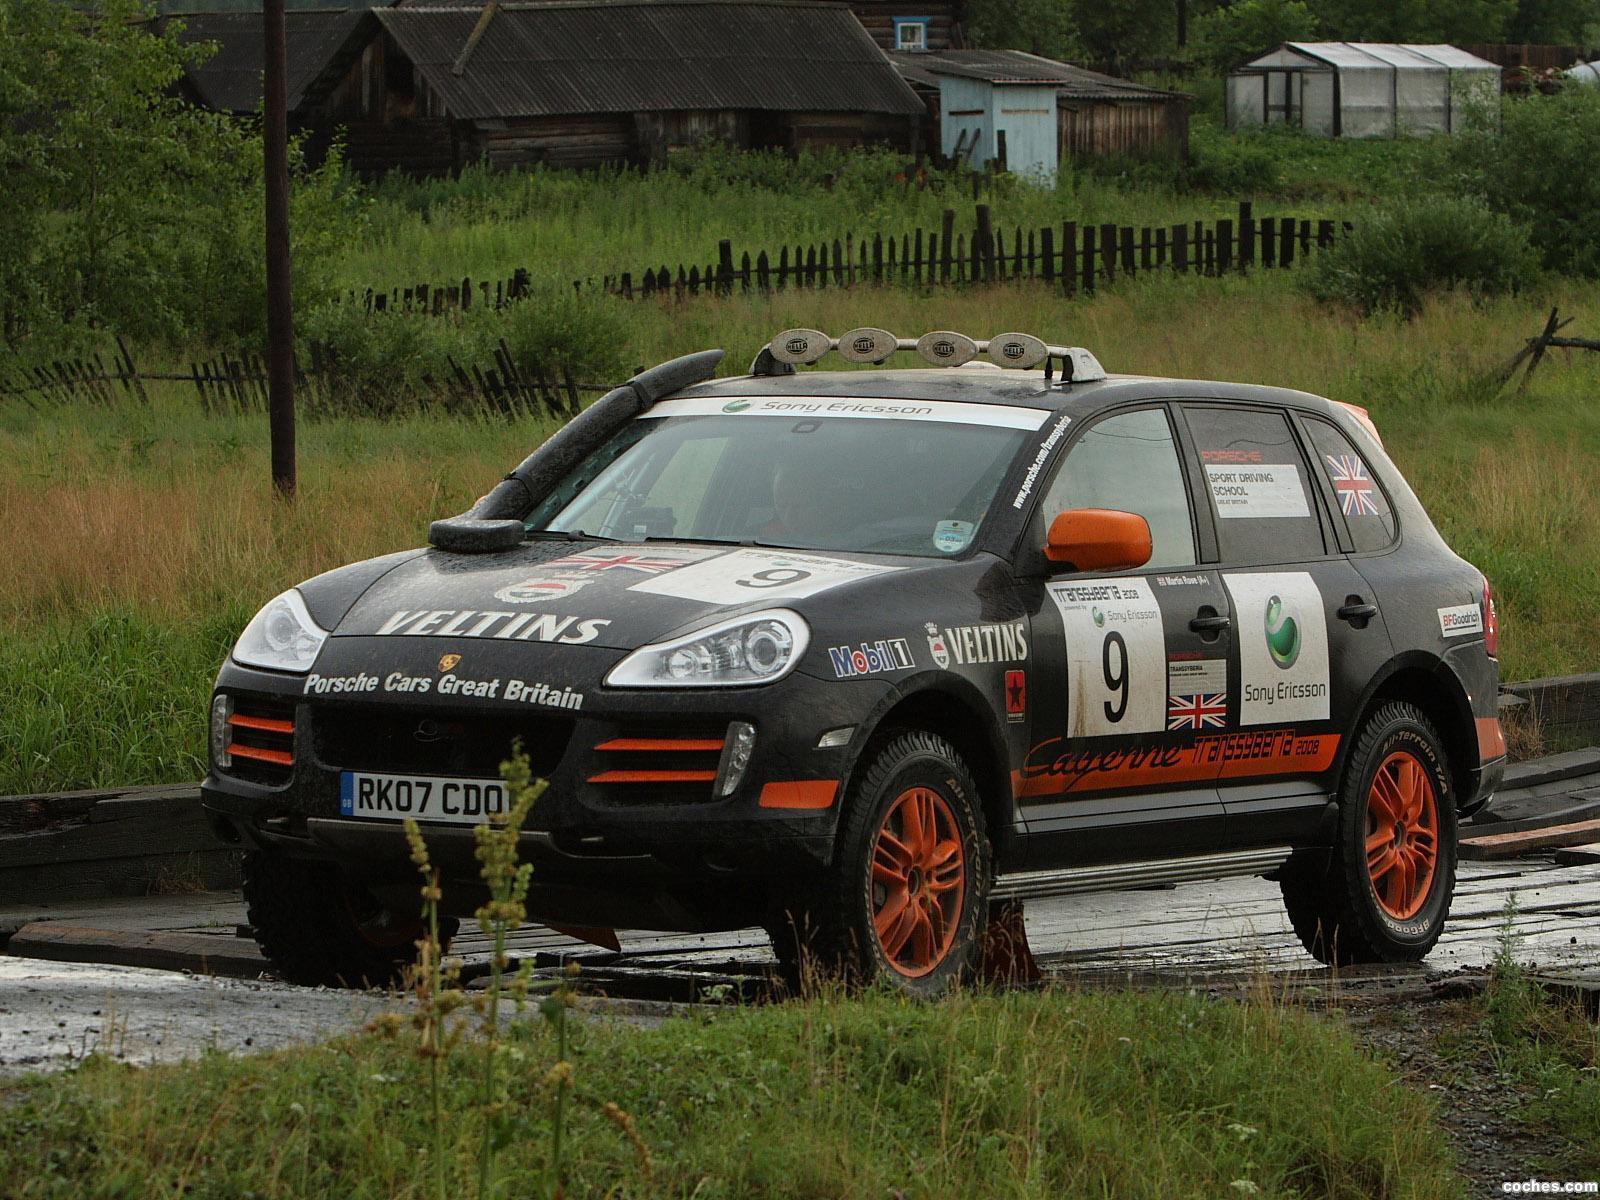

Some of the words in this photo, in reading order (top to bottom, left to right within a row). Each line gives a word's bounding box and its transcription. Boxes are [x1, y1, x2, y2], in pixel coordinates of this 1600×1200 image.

[760, 400, 824, 413] Sony
[827, 402, 933, 415] Ericsson
[1209, 473, 1237, 483] SPORT
[1239, 473, 1274, 483] DRIVING
[1213, 486, 1249, 496] SCHOOL
[735, 568, 812, 588] 9
[1122, 588, 1140, 600] 2008
[375, 610, 612, 644] VELTINS
[1107, 610, 1127, 623] Sony
[1127, 609, 1158, 621] Ericsson
[1442, 611, 1480, 627] BFGoodrich
[945, 623, 1028, 665] VELTINS
[828, 640, 896, 678] Mobil
[1102, 630, 1129, 723] 9
[303, 671, 380, 695] Porsche
[384, 671, 432, 693] Cars
[437, 674, 500, 699] Great
[503, 679, 585, 710] Britain
[1245, 683, 1275, 705] Sony
[1277, 681, 1326, 700] Ericsson
[1021, 736, 1182, 792] Cayenne
[1295, 739, 1320, 756] 2008
[358, 776, 433, 813] RK07
